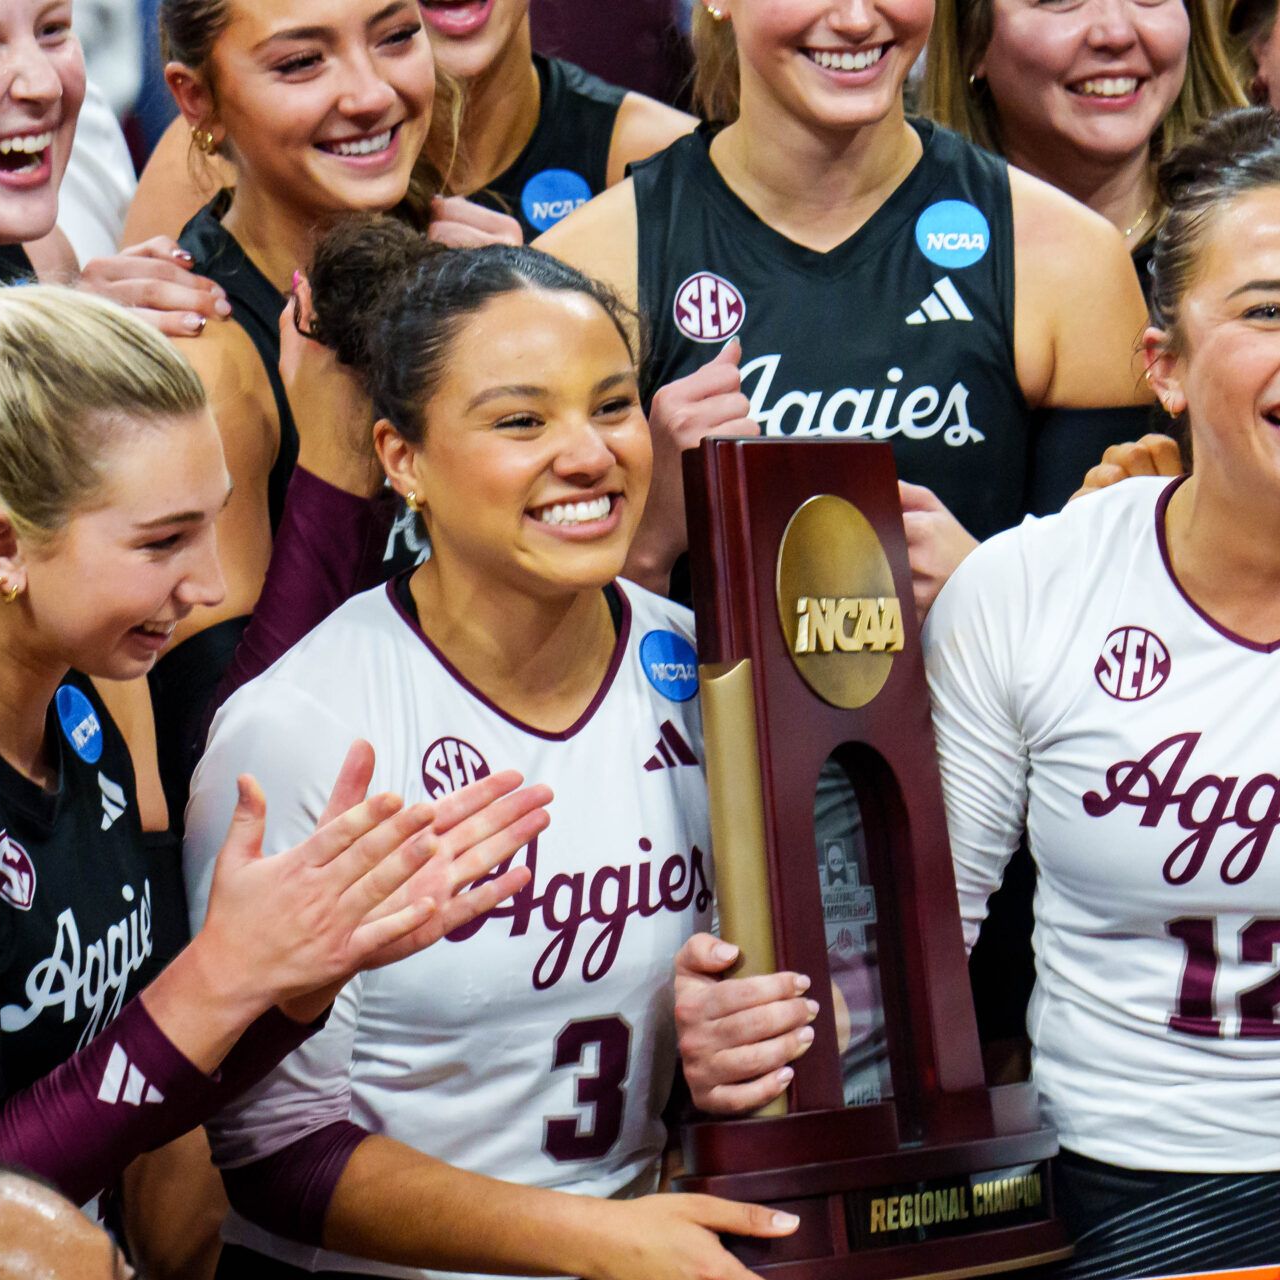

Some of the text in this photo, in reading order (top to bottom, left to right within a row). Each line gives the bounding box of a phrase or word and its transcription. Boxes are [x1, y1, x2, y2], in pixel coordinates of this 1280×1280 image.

[925, 232, 986, 252] NCAA
[676, 274, 741, 340] SEC
[1096, 627, 1171, 700] SEC
[540, 1013, 635, 1164] 3
[870, 1172, 1042, 1234] REGIONAL CHAMPION
